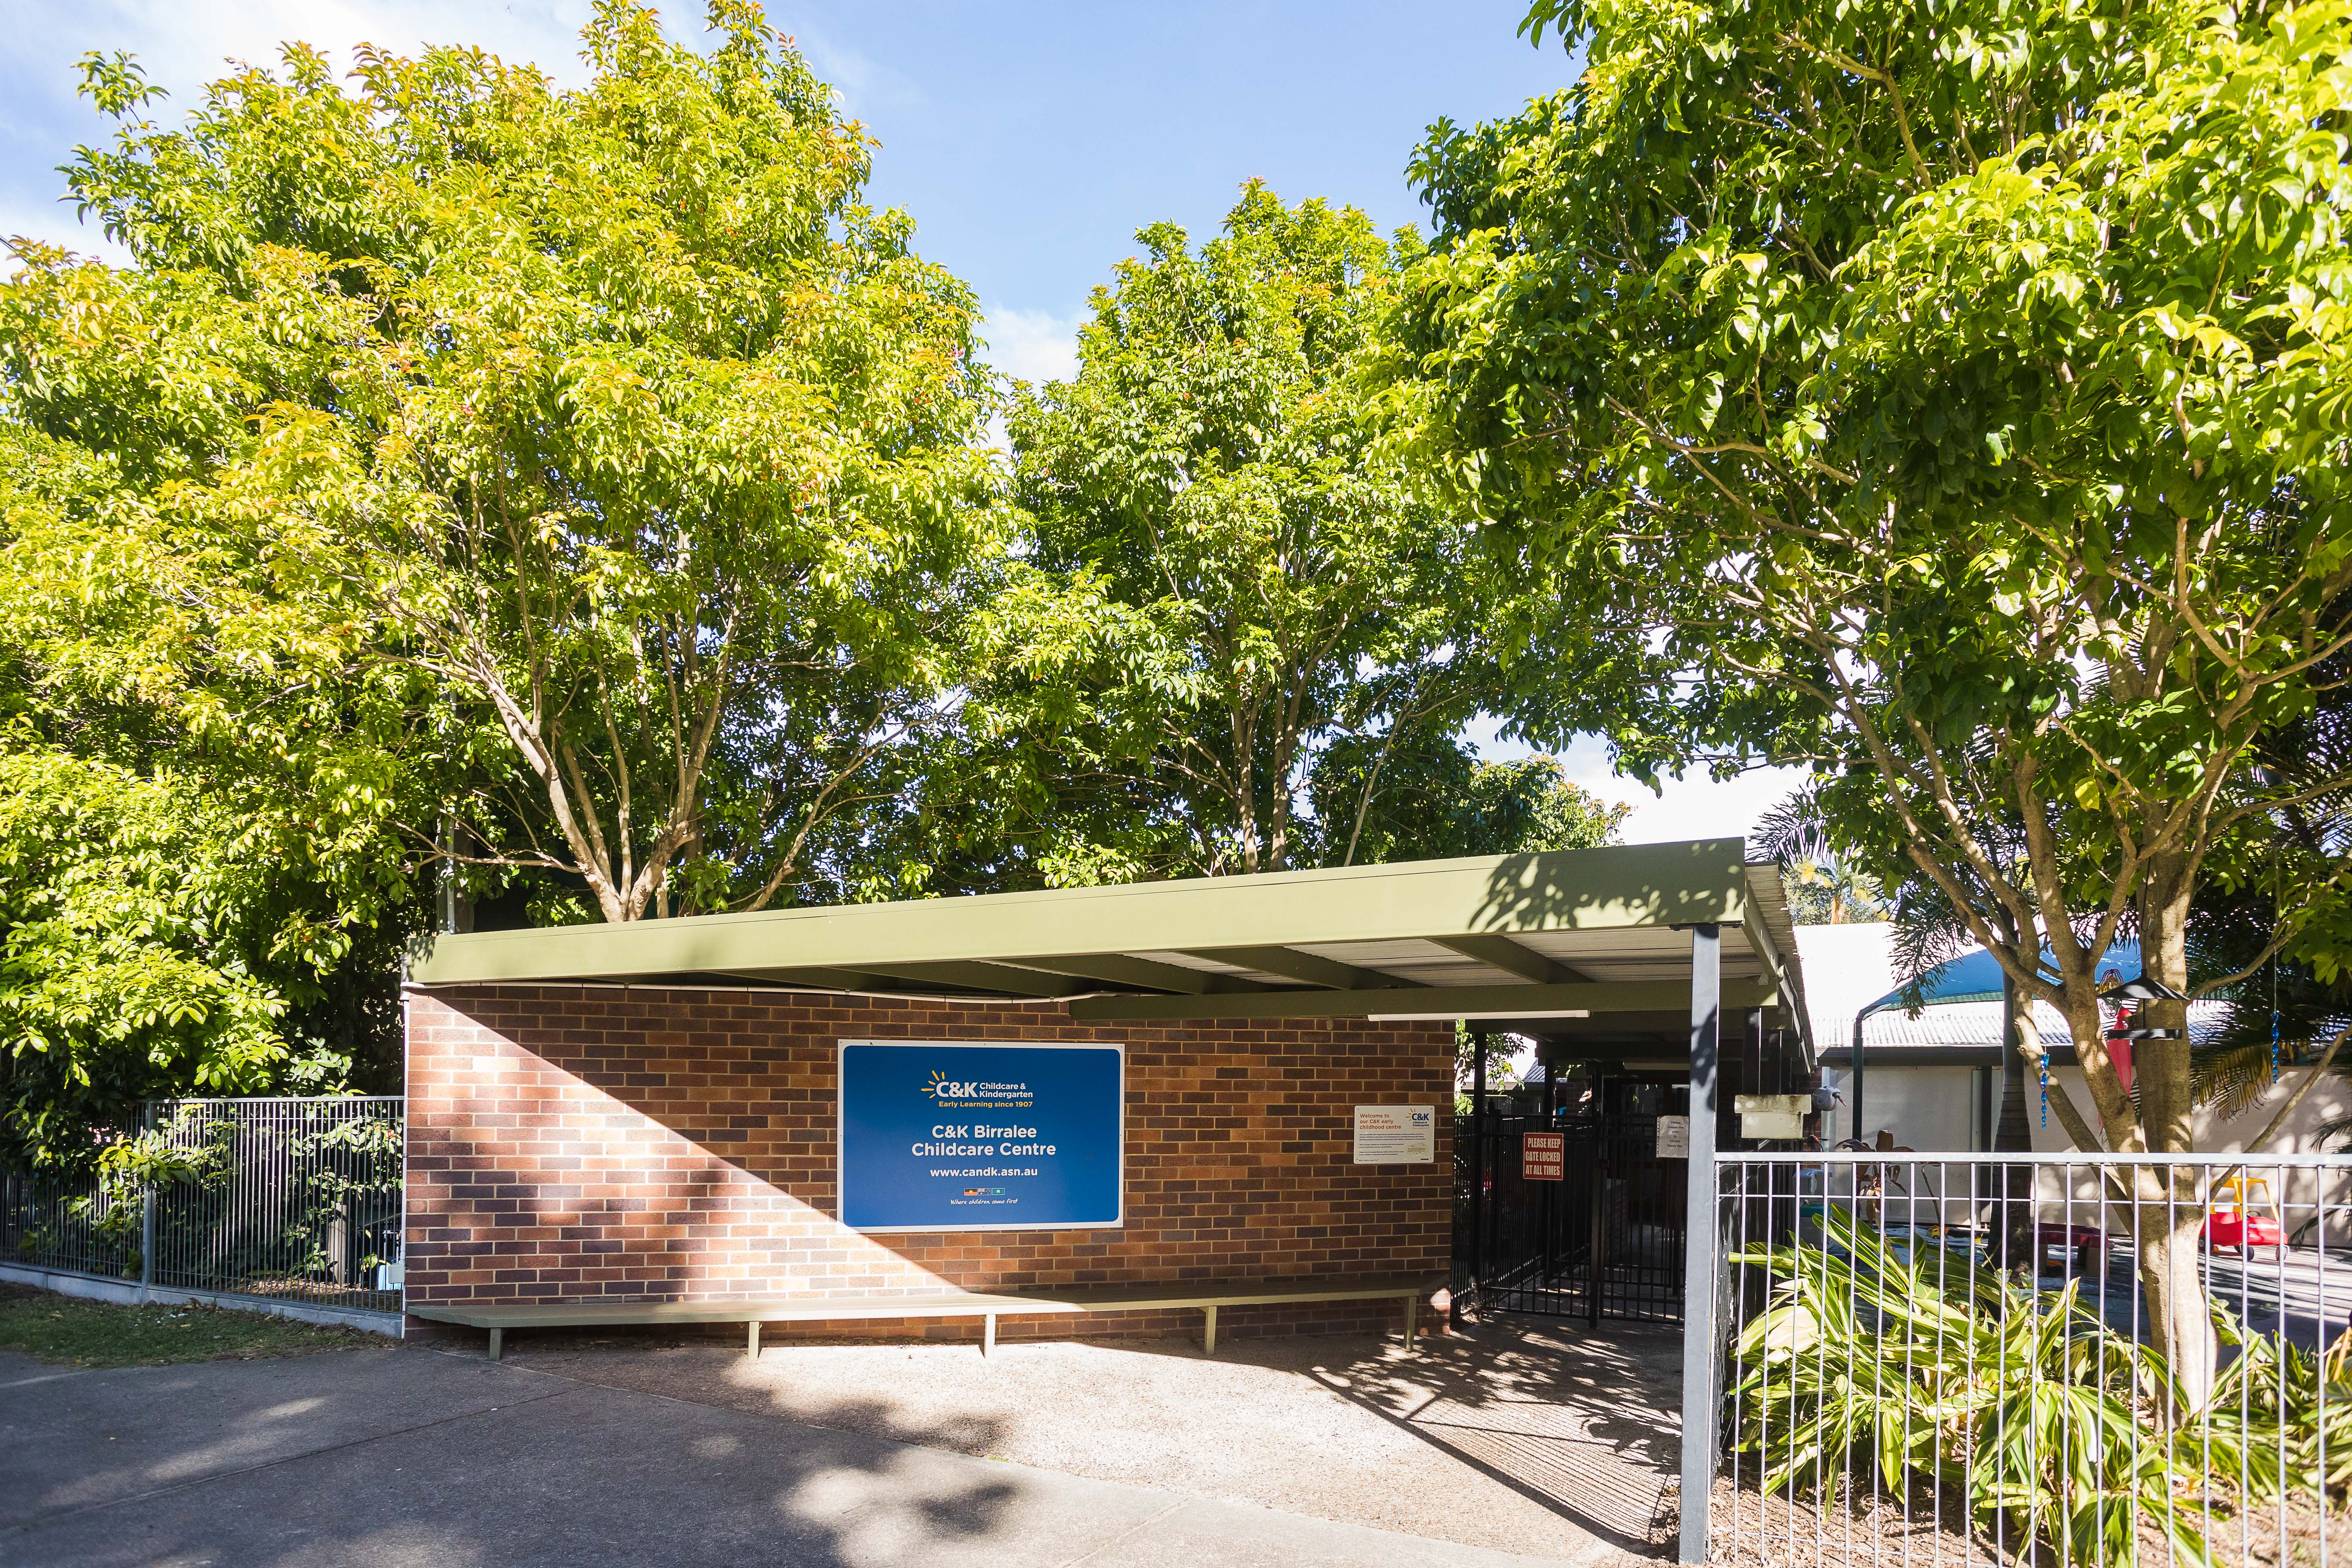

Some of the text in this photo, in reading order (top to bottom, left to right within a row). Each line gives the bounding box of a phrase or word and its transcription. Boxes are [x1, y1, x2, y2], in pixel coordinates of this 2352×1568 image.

[936, 1081, 978, 1098] C&K
[932, 1125, 1037, 1138] C&K Birralee
[1528, 1138, 1561, 1148] PLEASE KEEP
[912, 1142, 1057, 1156] Childcare Centre
[1525, 1151, 1560, 1162] GATE LOCKED
[930, 1167, 1038, 1177] www.candk.asn.au
[1525, 1165, 1560, 1176] AT ALL TIMES
